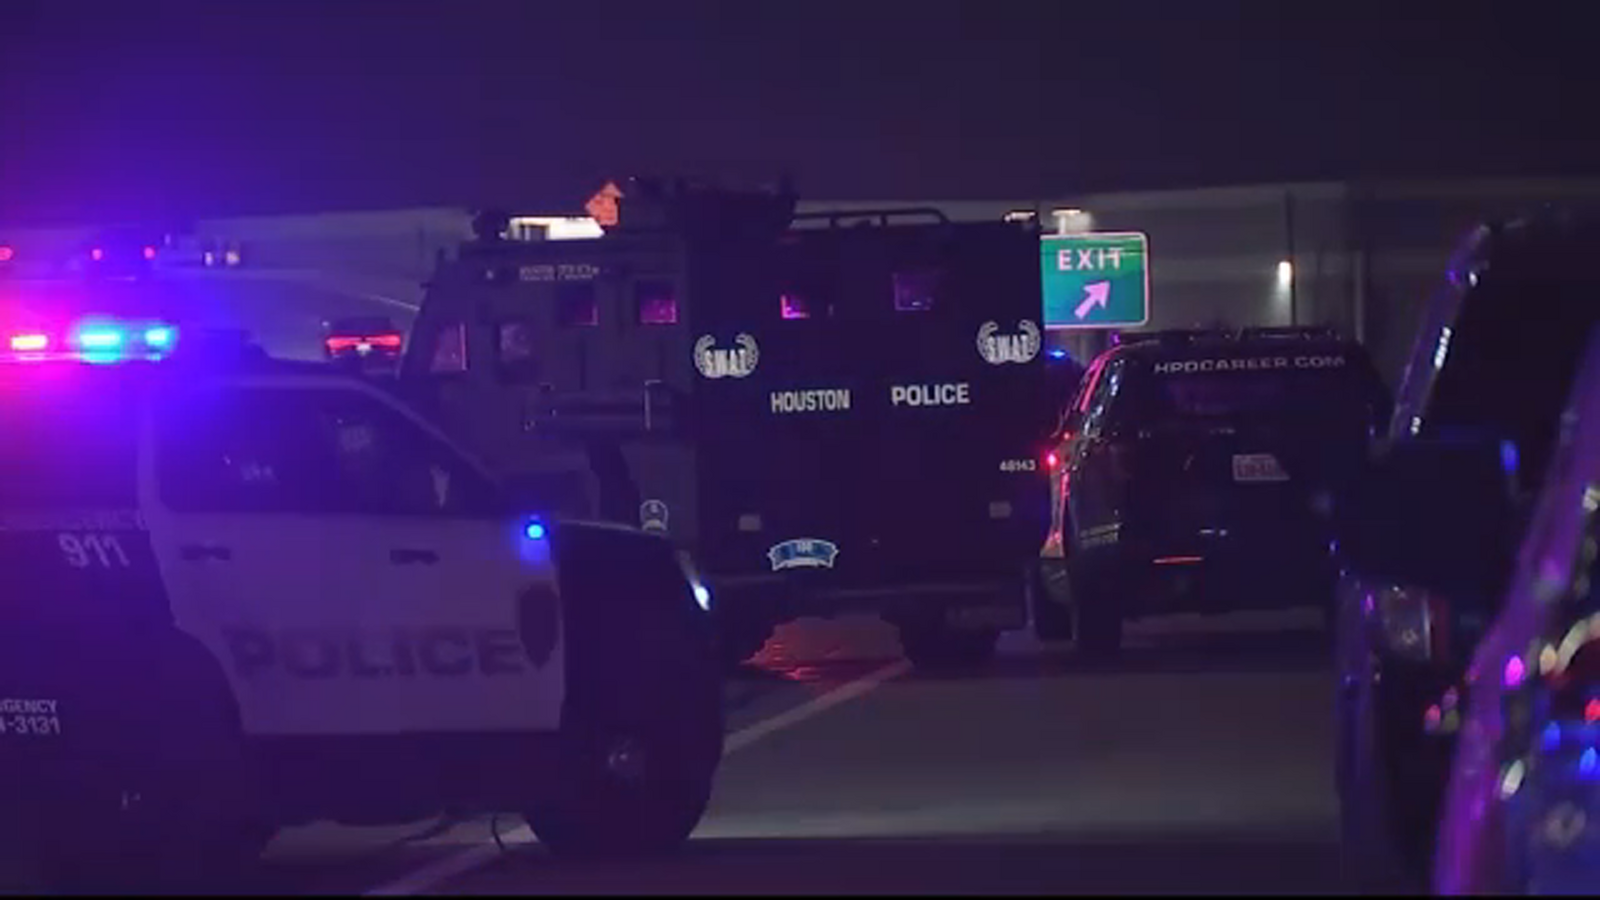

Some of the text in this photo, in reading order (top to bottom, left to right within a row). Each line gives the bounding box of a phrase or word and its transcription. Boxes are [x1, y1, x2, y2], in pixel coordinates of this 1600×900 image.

[1058, 247, 1122, 271] EXIT
[704, 348, 747, 377] SWAT
[987, 333, 1029, 363] SWAT
[1153, 355, 1346, 375] HPDCAREER.COM
[770, 383, 970, 413] HOUSTON POLICE
[58, 532, 131, 569] 911
[221, 626, 524, 681] POLICE
[0, 698, 57, 714] GENCY
